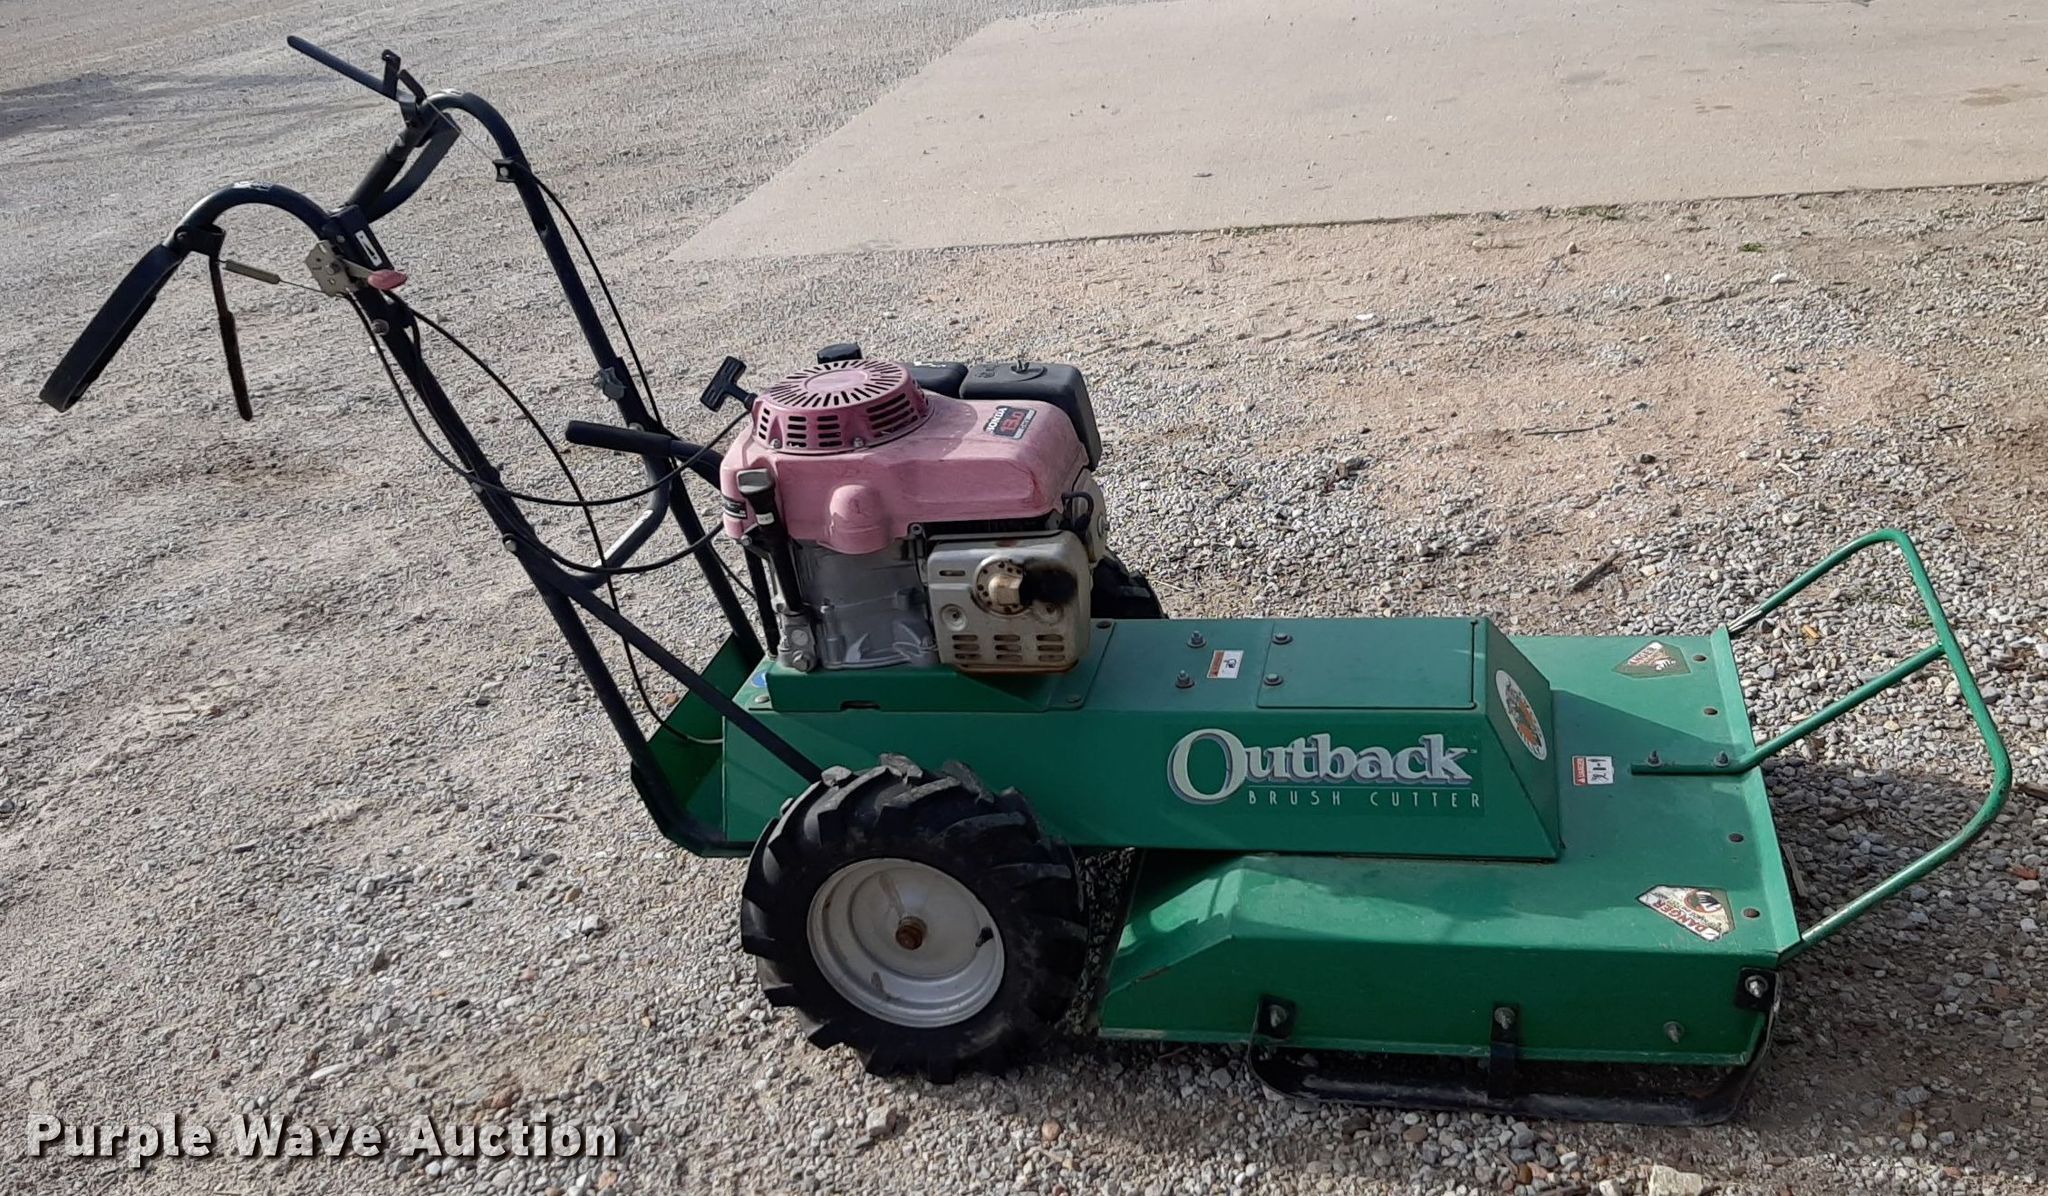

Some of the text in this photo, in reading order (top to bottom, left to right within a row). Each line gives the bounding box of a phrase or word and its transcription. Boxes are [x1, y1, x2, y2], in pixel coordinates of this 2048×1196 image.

[1167, 728, 1473, 805] Outback
[1248, 790, 1481, 809] BRUSH CUTTER
[1653, 899, 1709, 933] DANGER
